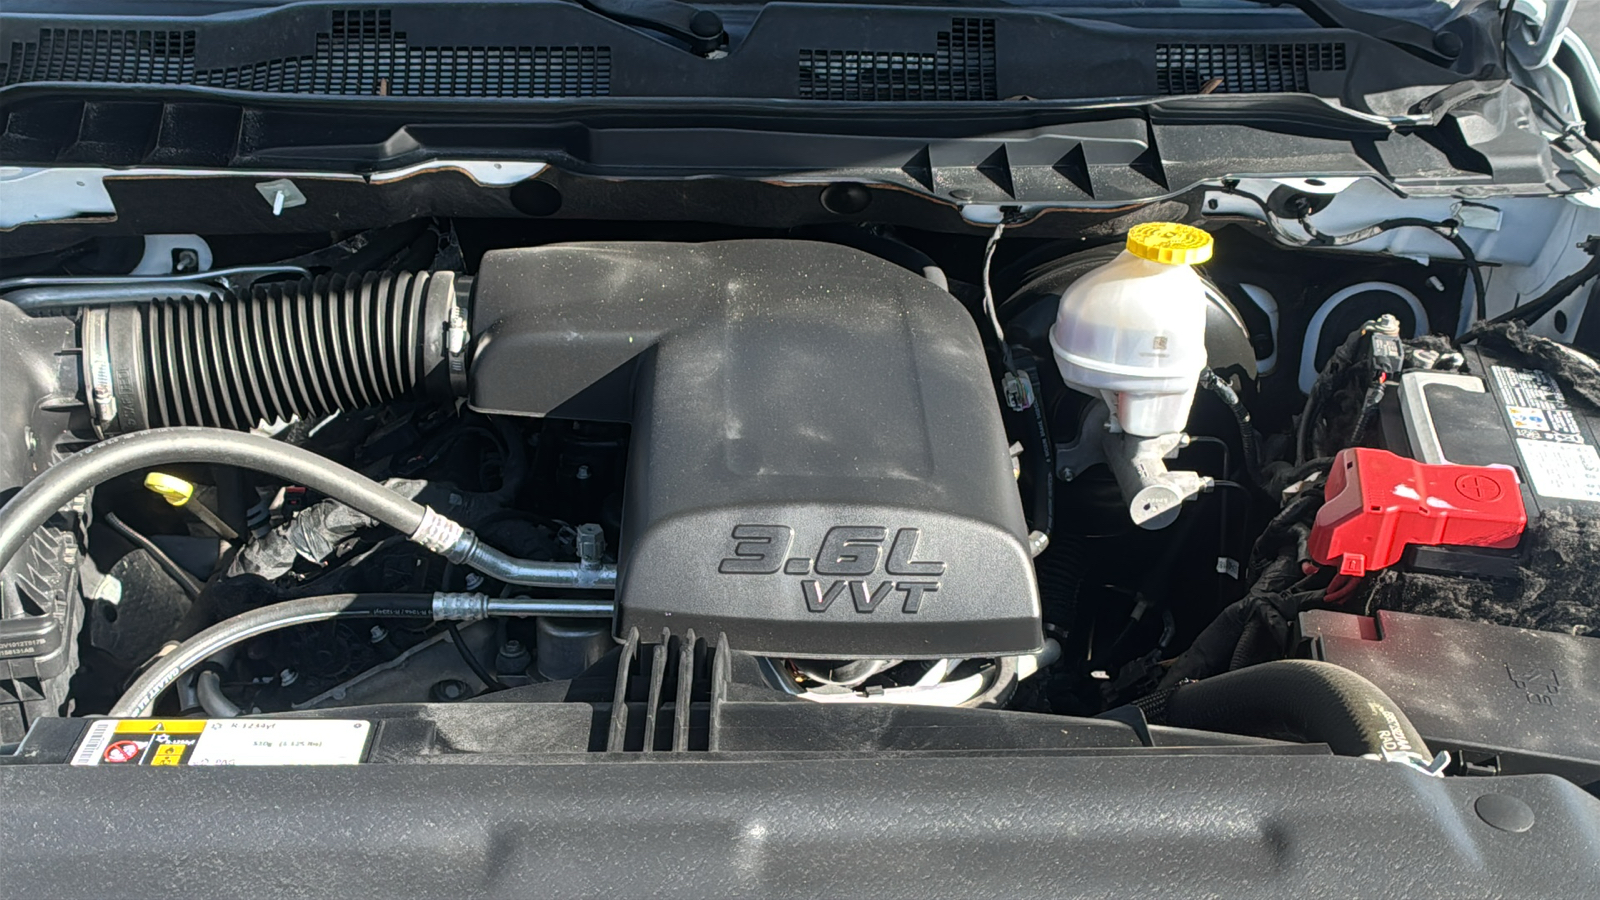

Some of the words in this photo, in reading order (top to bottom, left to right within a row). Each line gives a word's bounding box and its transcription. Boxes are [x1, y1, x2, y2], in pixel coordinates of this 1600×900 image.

[718, 524, 947, 576] 3.6L
[801, 579, 942, 613] VVT
[1377, 730, 1398, 750] RAD
